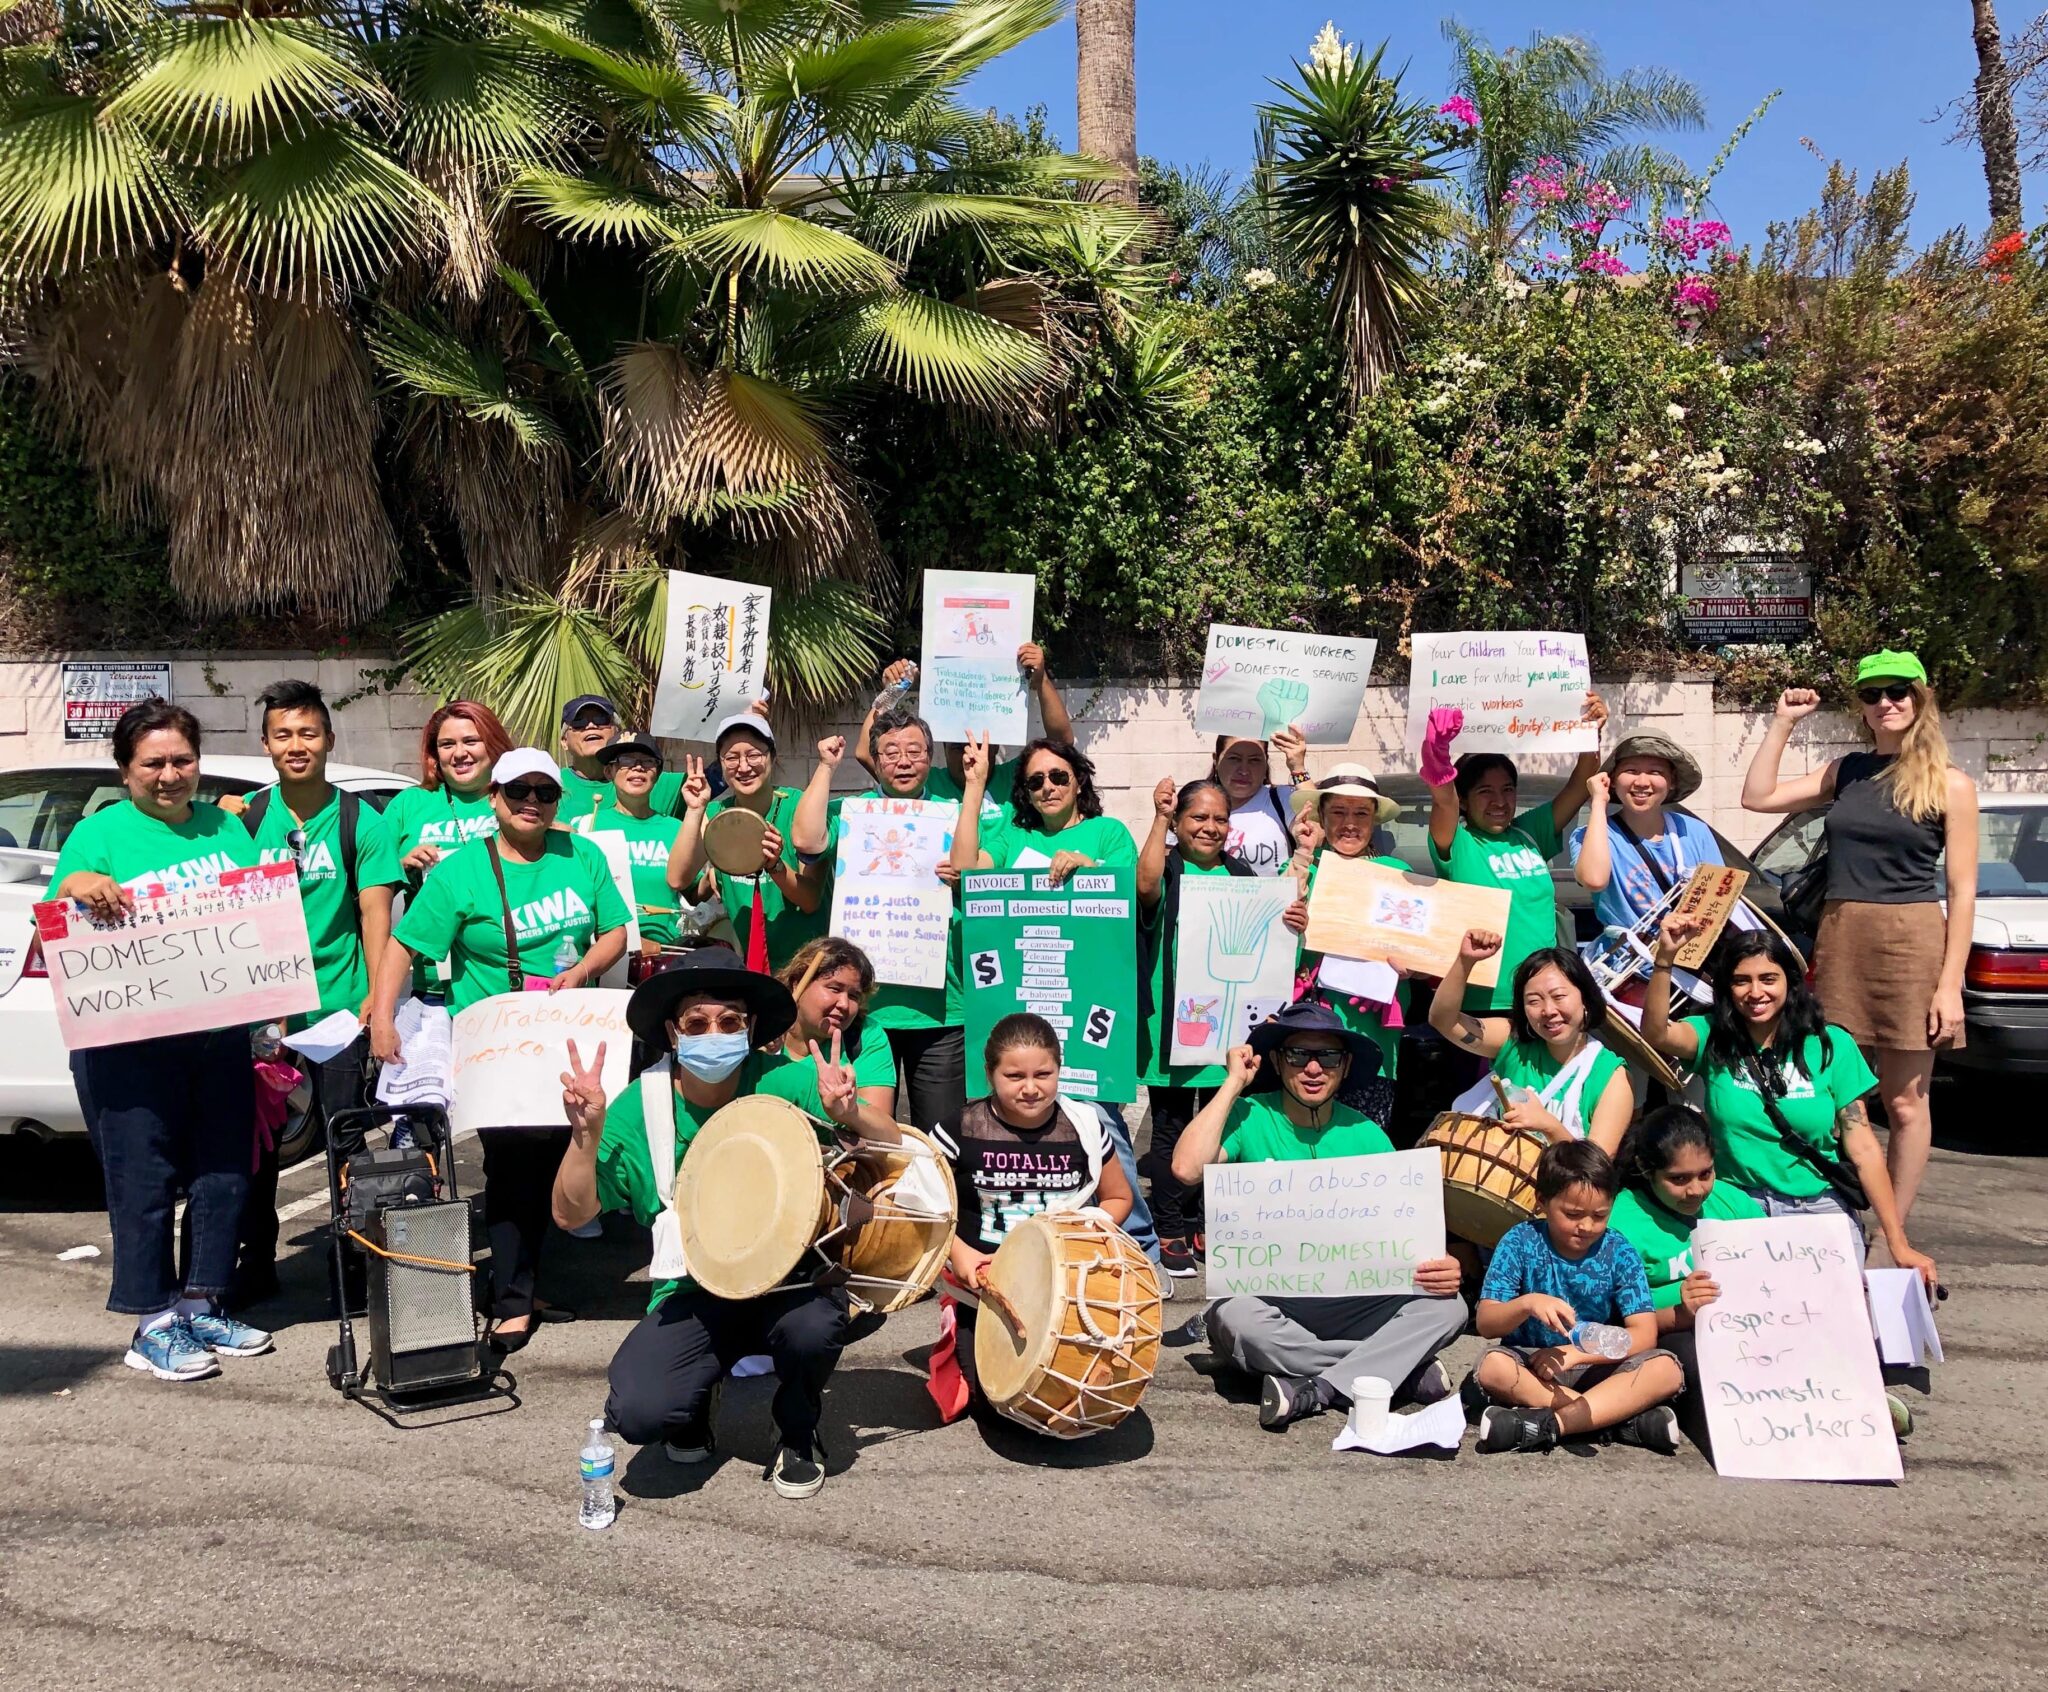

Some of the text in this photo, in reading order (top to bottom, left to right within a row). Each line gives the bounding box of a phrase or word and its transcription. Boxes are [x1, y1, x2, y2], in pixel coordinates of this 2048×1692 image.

[1706, 605, 1751, 617] MINUTE
[1755, 604, 1805, 616] PARKING
[1215, 634, 1357, 661] DOMESTIC WORKERS
[1427, 640, 1456, 661] Your
[1459, 639, 1505, 659] Children
[1513, 639, 1538, 658] Your
[1205, 655, 1359, 683] NOT DOMESTIC SERVANTS
[1432, 665, 1571, 688] I care for what you value
[1560, 677, 1587, 693] most
[70, 707, 123, 718] 30 MINUTE
[1429, 695, 1524, 711] Domestic workers
[1462, 722, 1506, 734] eserve
[1507, 715, 1544, 739] dignity
[420, 815, 500, 838] KIWA
[155, 850, 240, 884] KIWA
[1488, 848, 1547, 873] KIWA
[304, 871, 337, 881] JUSTICE
[968, 876, 1020, 890] INVOICE
[1076, 877, 1109, 890] GARY
[502, 886, 590, 934] KIWA
[969, 901, 1123, 916] From domestic workers
[544, 923, 561, 934] FOR
[562, 915, 591, 929] JUSTICE
[1034, 927, 1060, 936] driver
[58, 921, 260, 980] DOMESTIC
[1030, 941, 1071, 950] carwasher
[975, 953, 997, 985] $
[1028, 953, 1059, 962] cleaner
[1038, 965, 1062, 974] house
[67, 953, 312, 1017] WORK IS WORK
[1034, 978, 1066, 987] laundry
[1029, 990, 1070, 1001] babysitter
[1038, 1004, 1060, 1014] party
[1086, 1007, 1111, 1043] $
[1070, 1070, 1095, 1080] maker
[982, 1151, 1071, 1171] TOTALLY
[993, 1172, 1030, 1187] HOT
[1036, 1170, 1080, 1188] MESS
[1213, 1164, 1425, 1197] Alto al abuso de
[1214, 1198, 1416, 1224] las trabajadoras de
[1212, 1237, 1416, 1270] STOP DOMESTIC
[1699, 1240, 1846, 1275] Fair Wages
[1225, 1266, 1417, 1295] WORKER ABUSE
[1708, 1300, 1824, 1338] respect
[1735, 1339, 1794, 1368] for
[1716, 1378, 1853, 1407] Domestic
[1734, 1411, 1877, 1447] Workers
